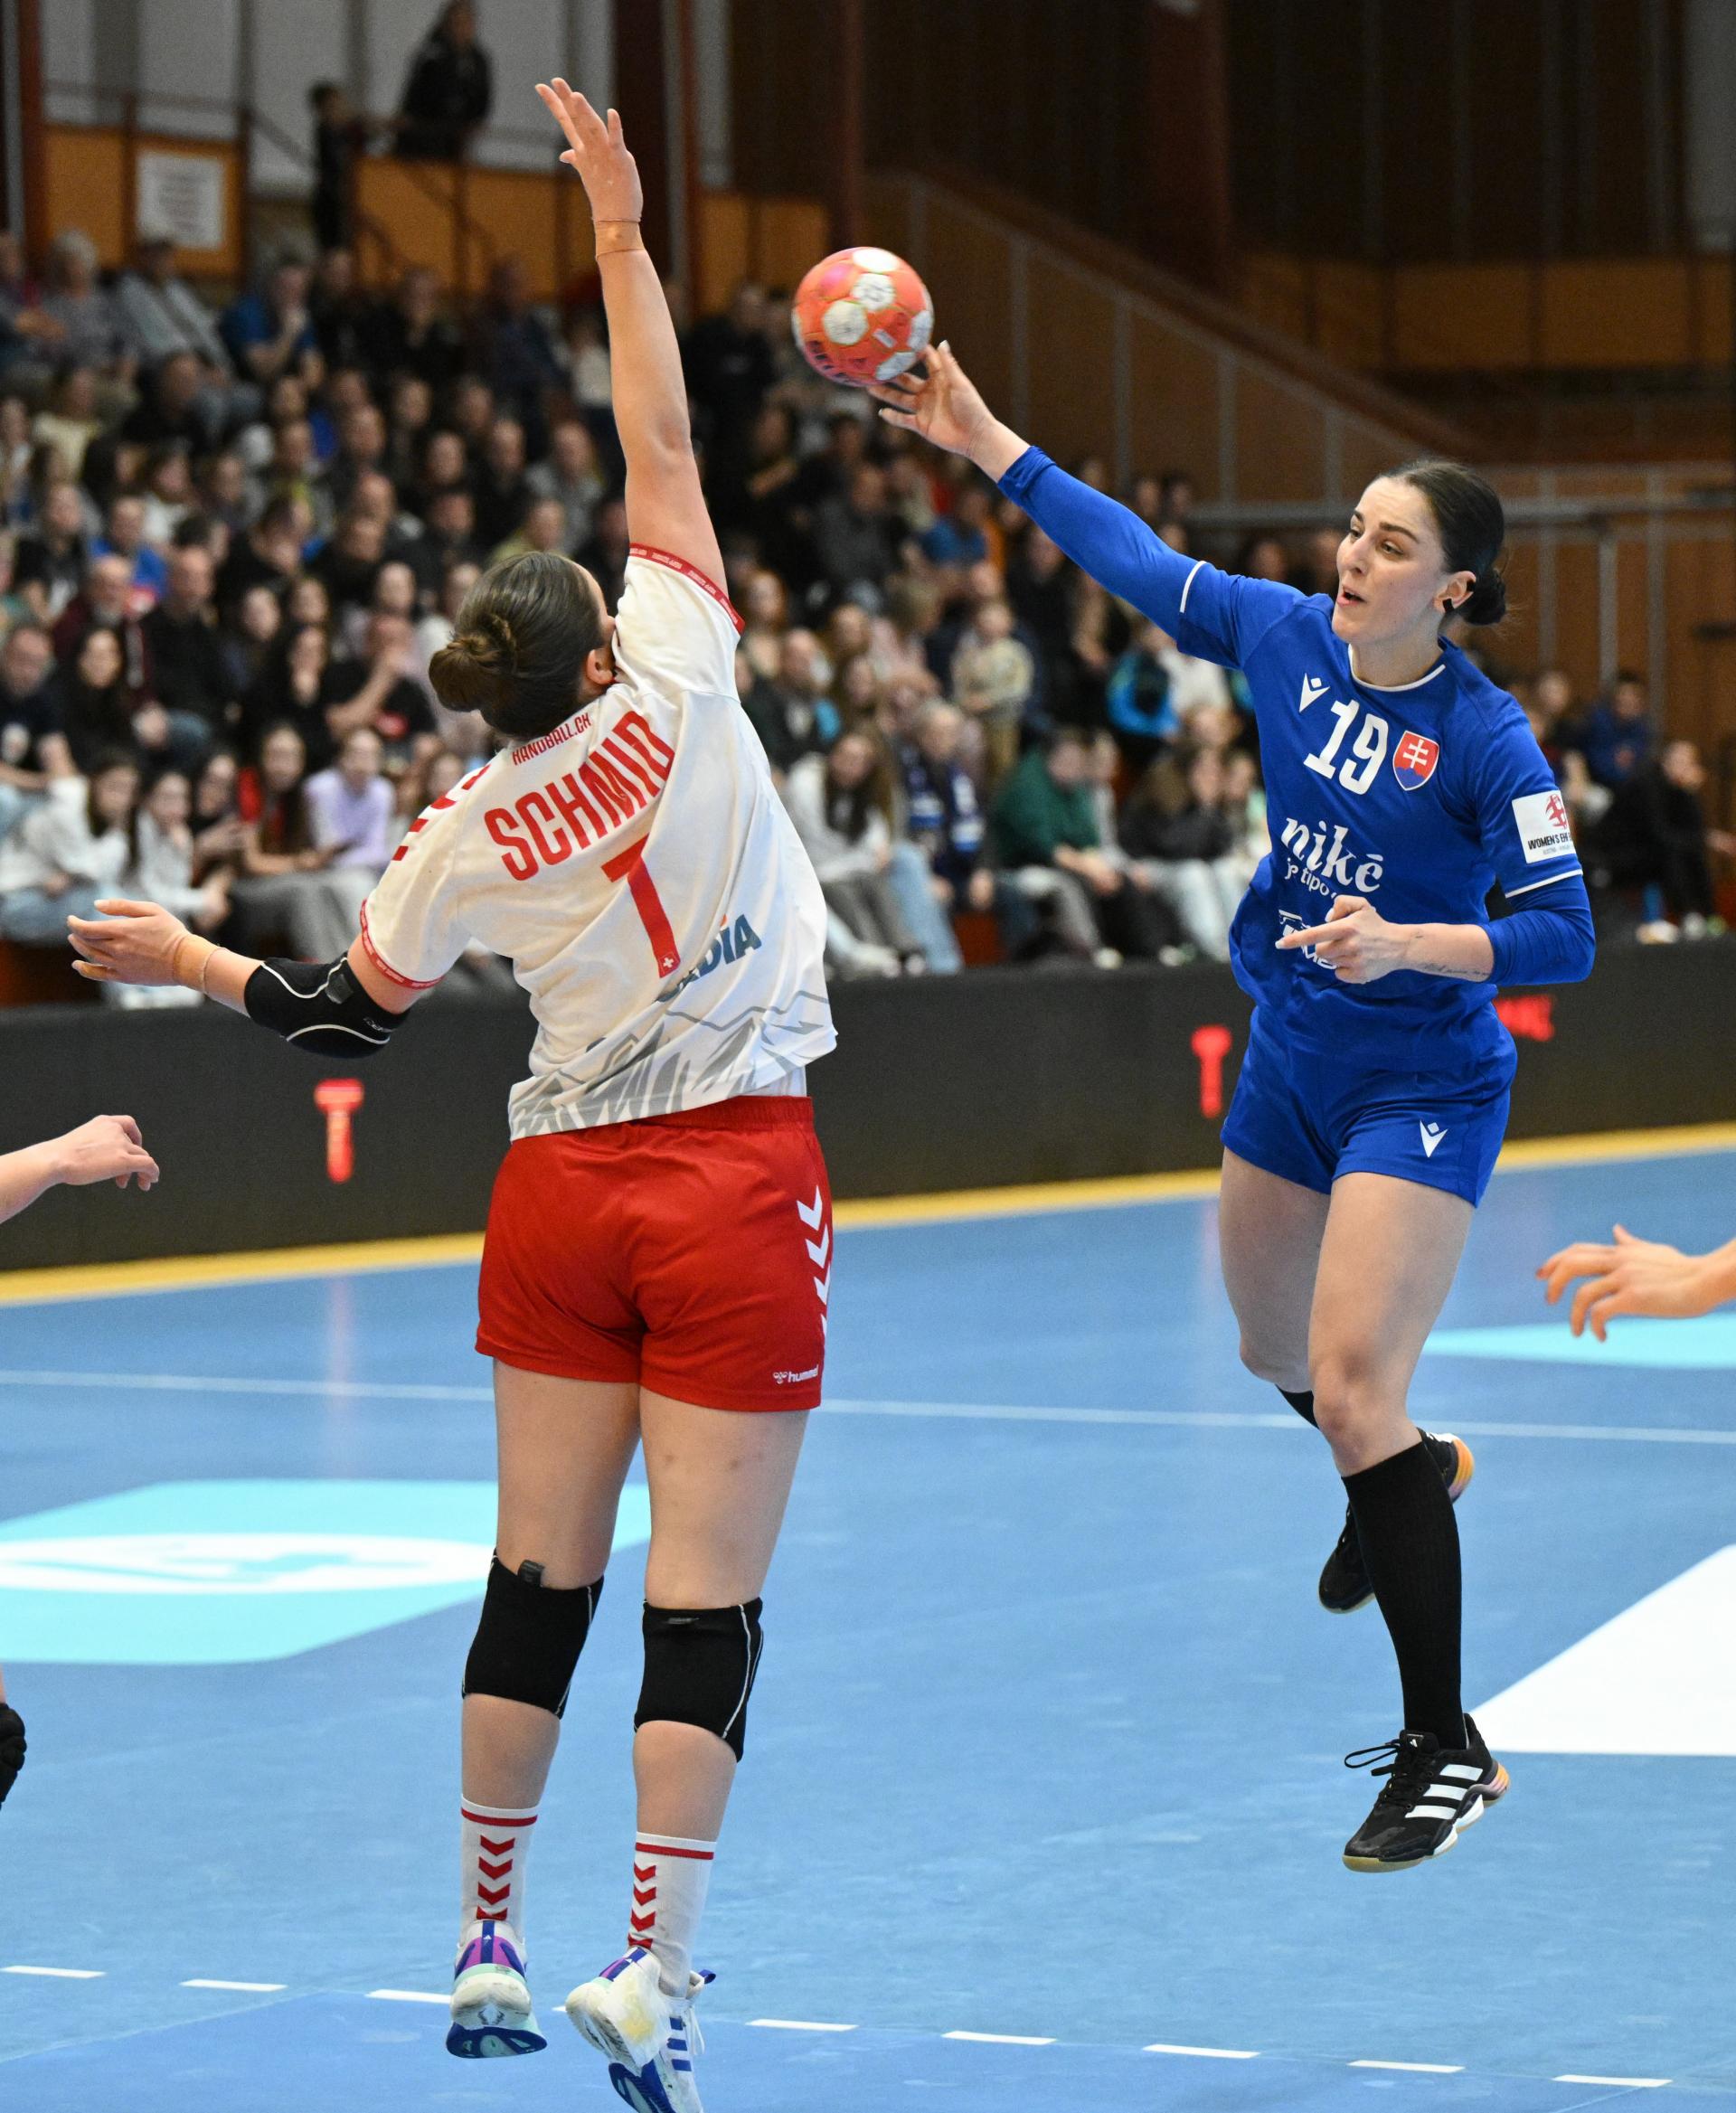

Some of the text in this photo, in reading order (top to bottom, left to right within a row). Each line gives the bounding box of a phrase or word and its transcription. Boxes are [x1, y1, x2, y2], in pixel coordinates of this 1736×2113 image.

[512, 712, 592, 766] HANDBALL.CH
[1304, 699, 1389, 795] 19
[484, 711, 676, 882] SCHMID
[1527, 835, 1561, 851] WOMEN'S
[600, 833, 682, 978] 7
